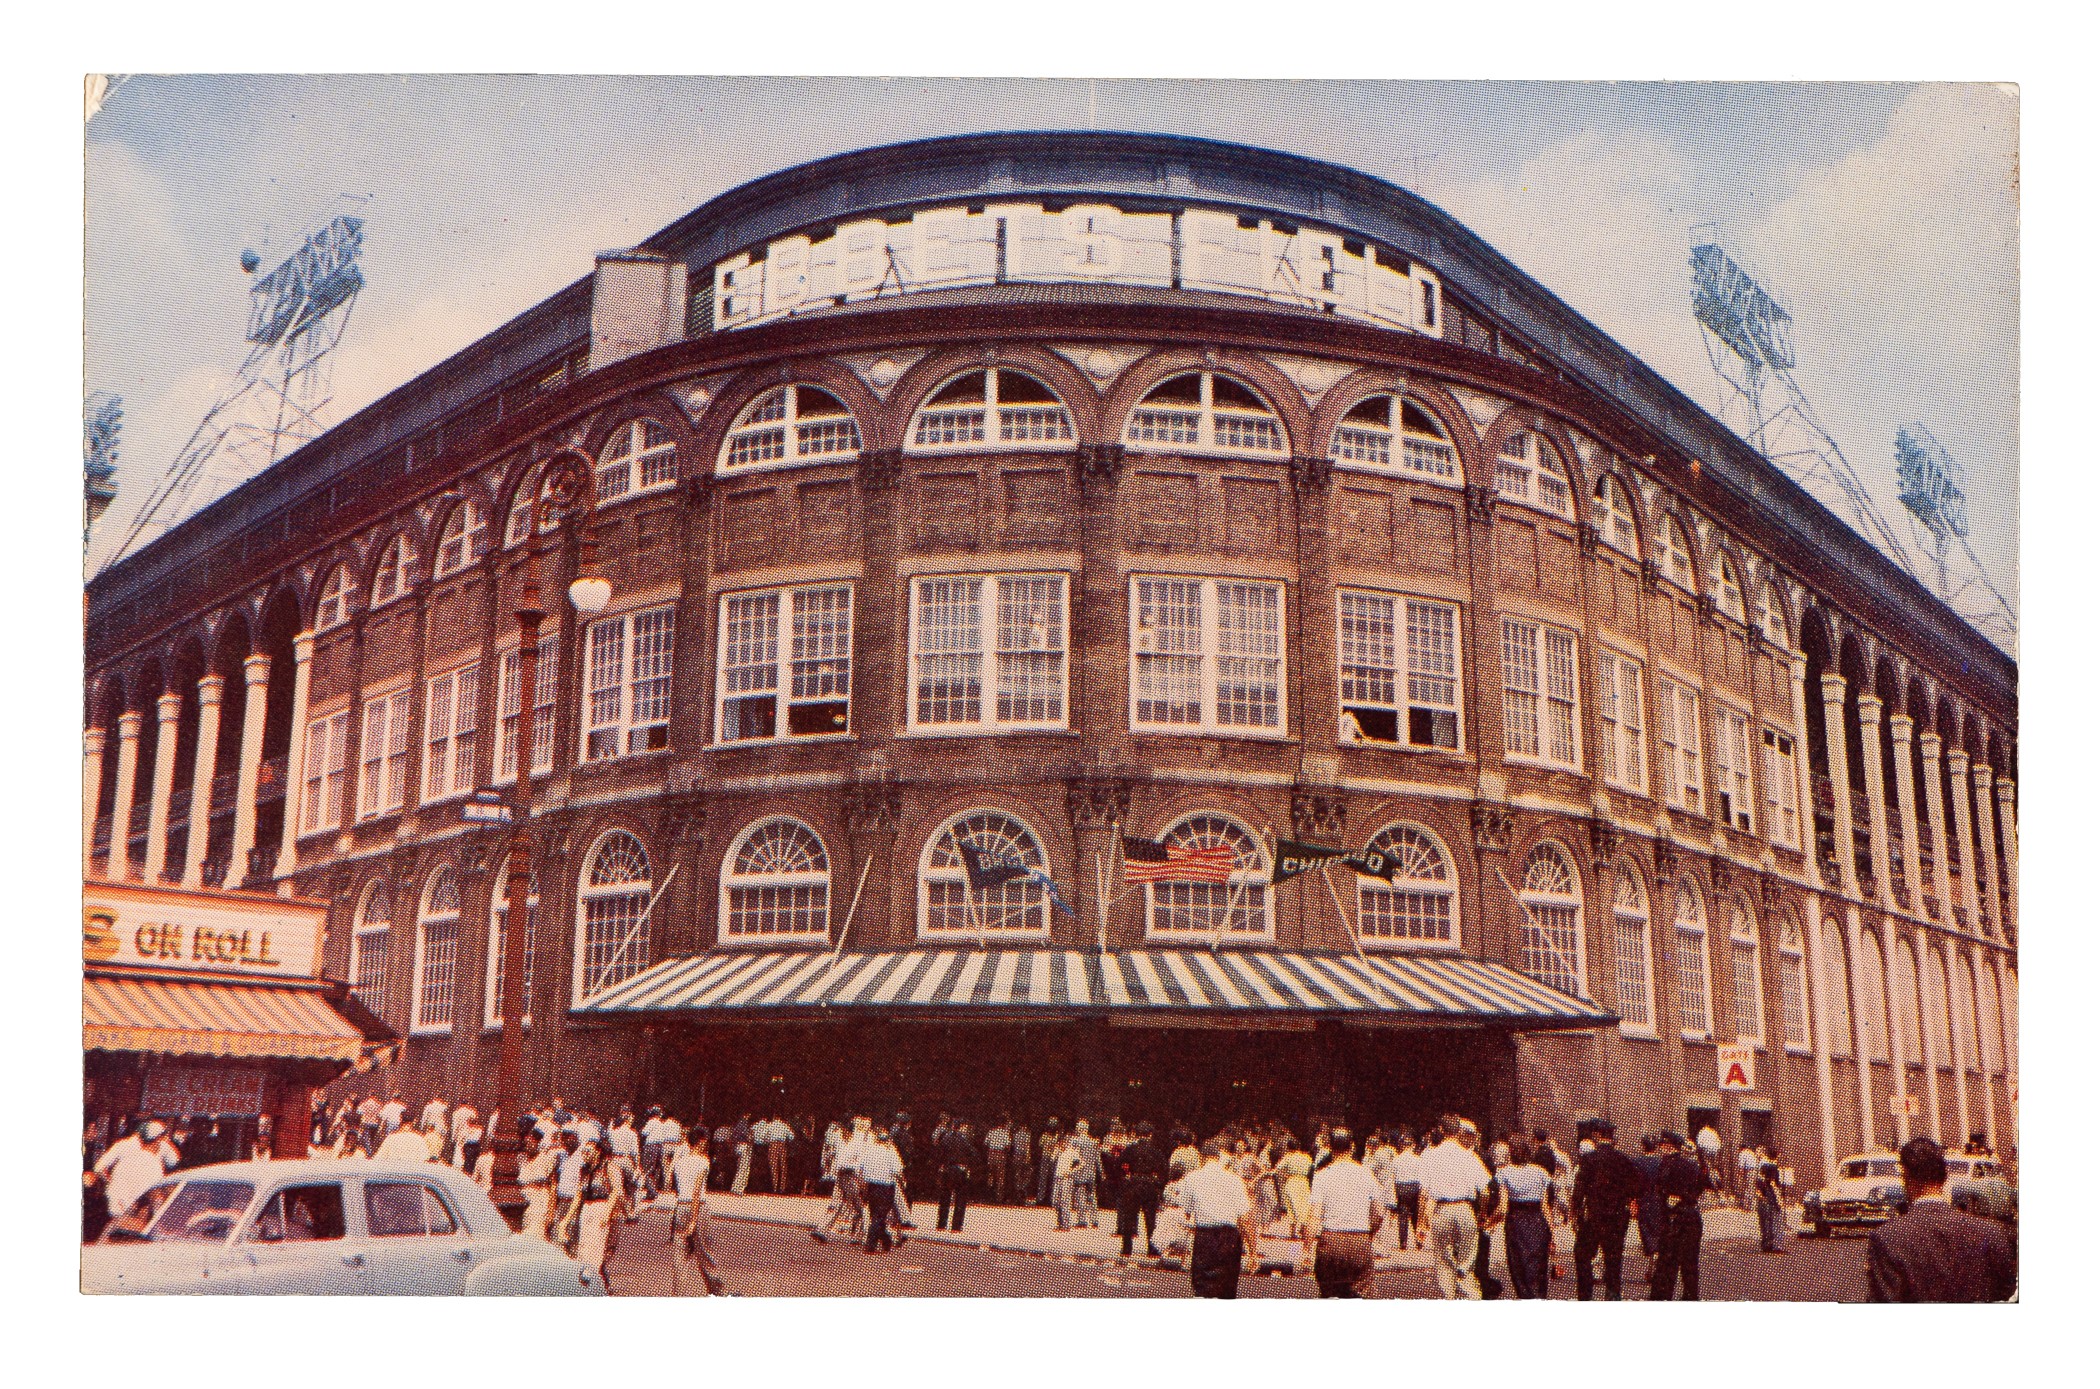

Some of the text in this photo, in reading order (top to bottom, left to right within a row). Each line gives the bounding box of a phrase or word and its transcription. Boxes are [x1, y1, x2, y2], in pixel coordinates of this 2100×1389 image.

[713, 202, 1444, 338] EBBETS FIELD
[135, 922, 183, 960] ON
[192, 925, 280, 966] ROLL
[1721, 1050, 1748, 1061] GATE
[1725, 1062, 1748, 1086] A
